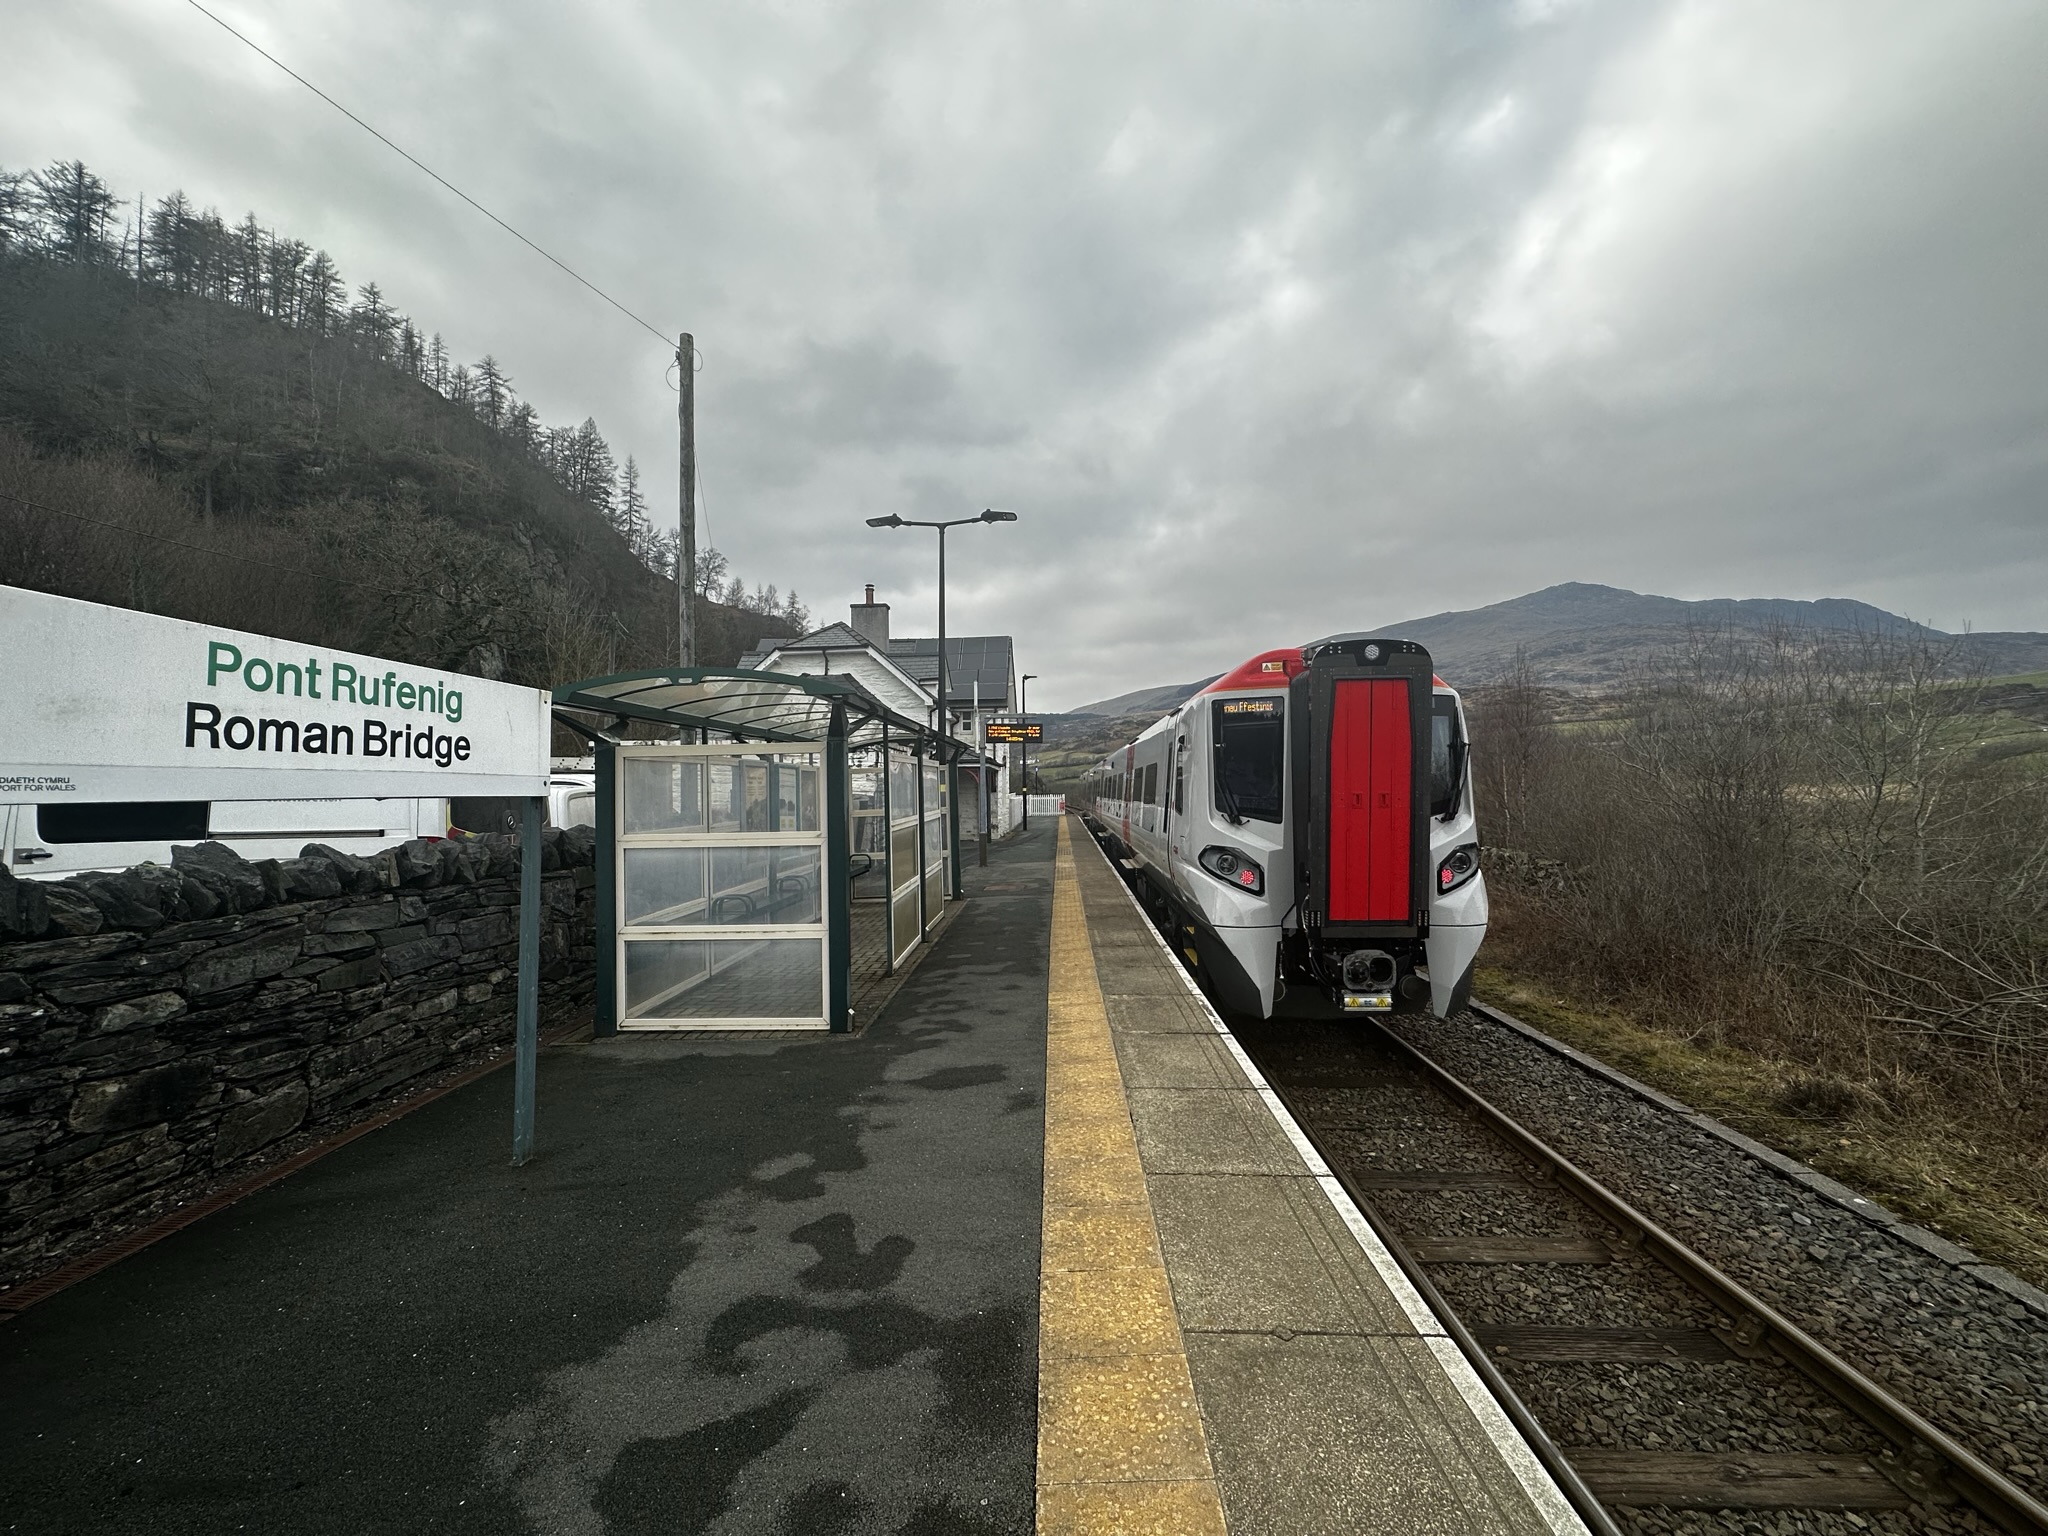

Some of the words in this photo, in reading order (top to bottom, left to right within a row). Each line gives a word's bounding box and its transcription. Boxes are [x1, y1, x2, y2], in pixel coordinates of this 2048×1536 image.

[207, 640, 322, 699] Pont
[331, 662, 463, 723] Rufenig
[185, 701, 354, 755] Roman
[363, 719, 471, 768] Bridge
